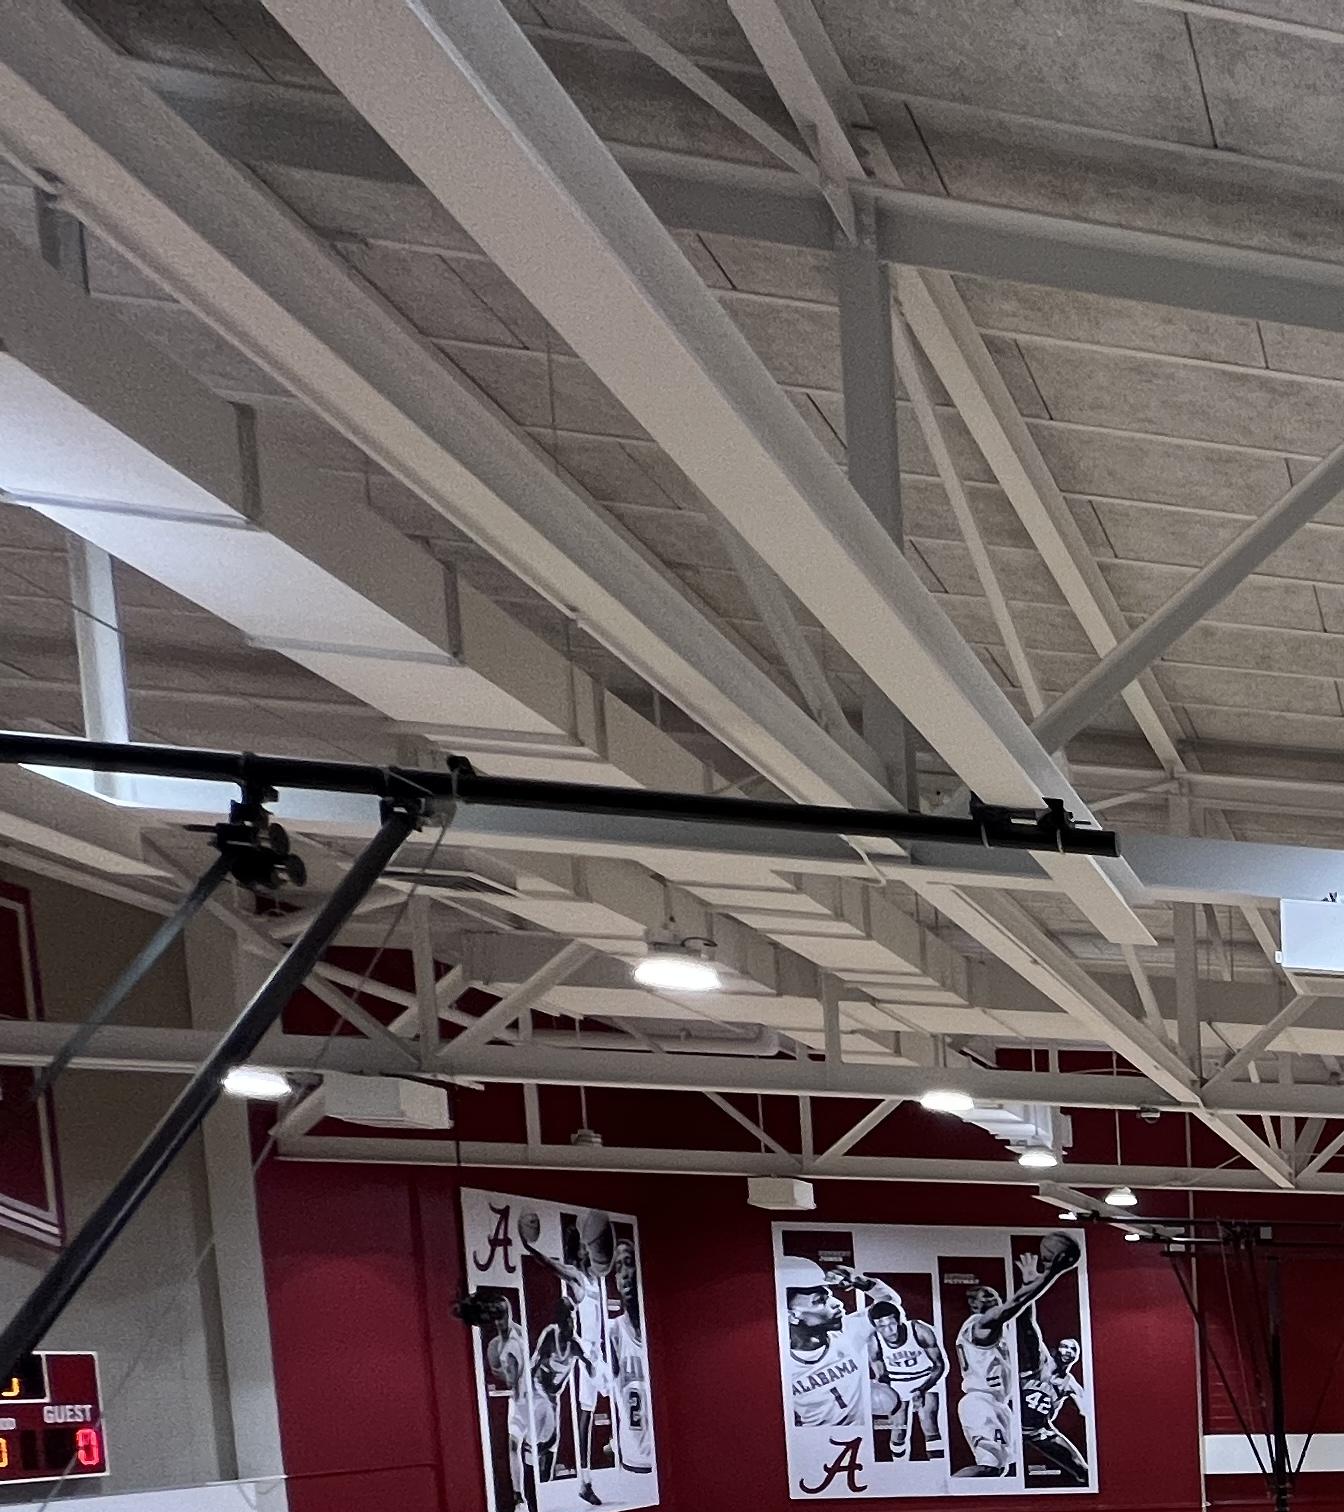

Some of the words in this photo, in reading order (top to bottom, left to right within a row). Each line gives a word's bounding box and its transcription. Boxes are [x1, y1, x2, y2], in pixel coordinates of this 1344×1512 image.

[473, 1202, 516, 1273] A
[792, 1359, 859, 1396] ALABAMA
[829, 1386, 848, 1409] 1
[1025, 1391, 1053, 1415] 42
[43, 1405, 93, 1423] GUEST
[799, 1436, 868, 1494] A
